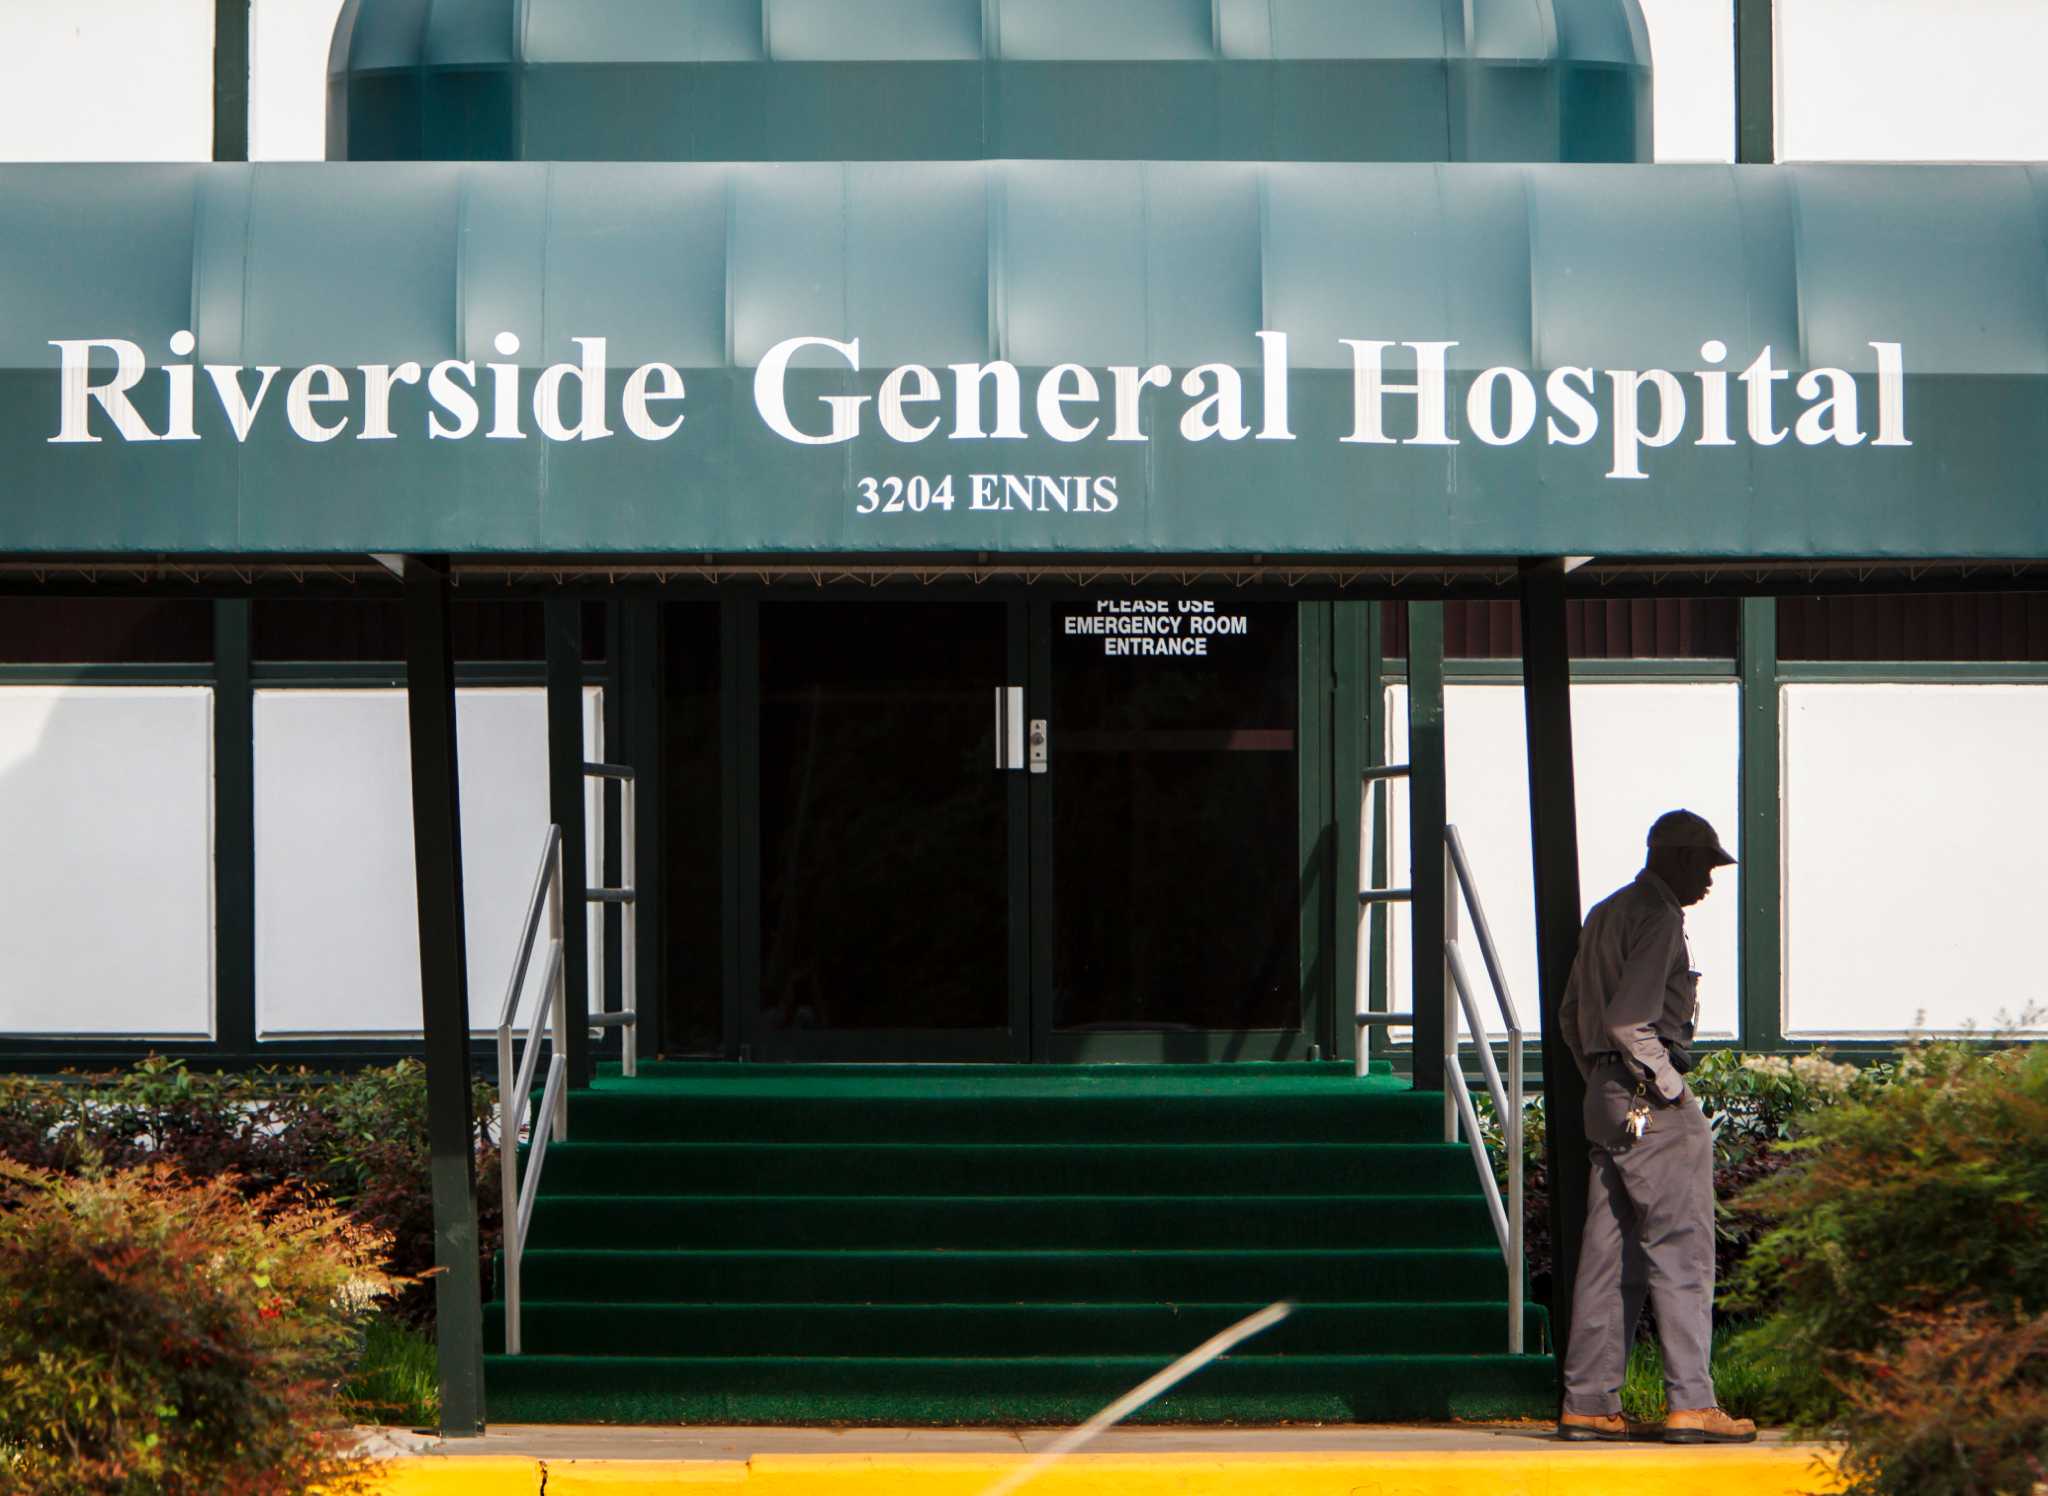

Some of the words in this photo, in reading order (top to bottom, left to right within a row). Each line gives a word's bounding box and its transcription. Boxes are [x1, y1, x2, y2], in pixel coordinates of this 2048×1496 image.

[47, 330, 686, 442] Riverside
[753, 330, 1296, 445] General
[1338, 338, 1913, 479] Hospital
[856, 474, 955, 514] 3204
[968, 474, 1119, 513] ENNIS
[1097, 600, 1169, 613] PLEASE
[1178, 600, 1215, 613] USE
[1064, 616, 1183, 635] EMERGENCY
[1190, 616, 1247, 635] ROOM
[1104, 637, 1208, 656] ENTRANCE
